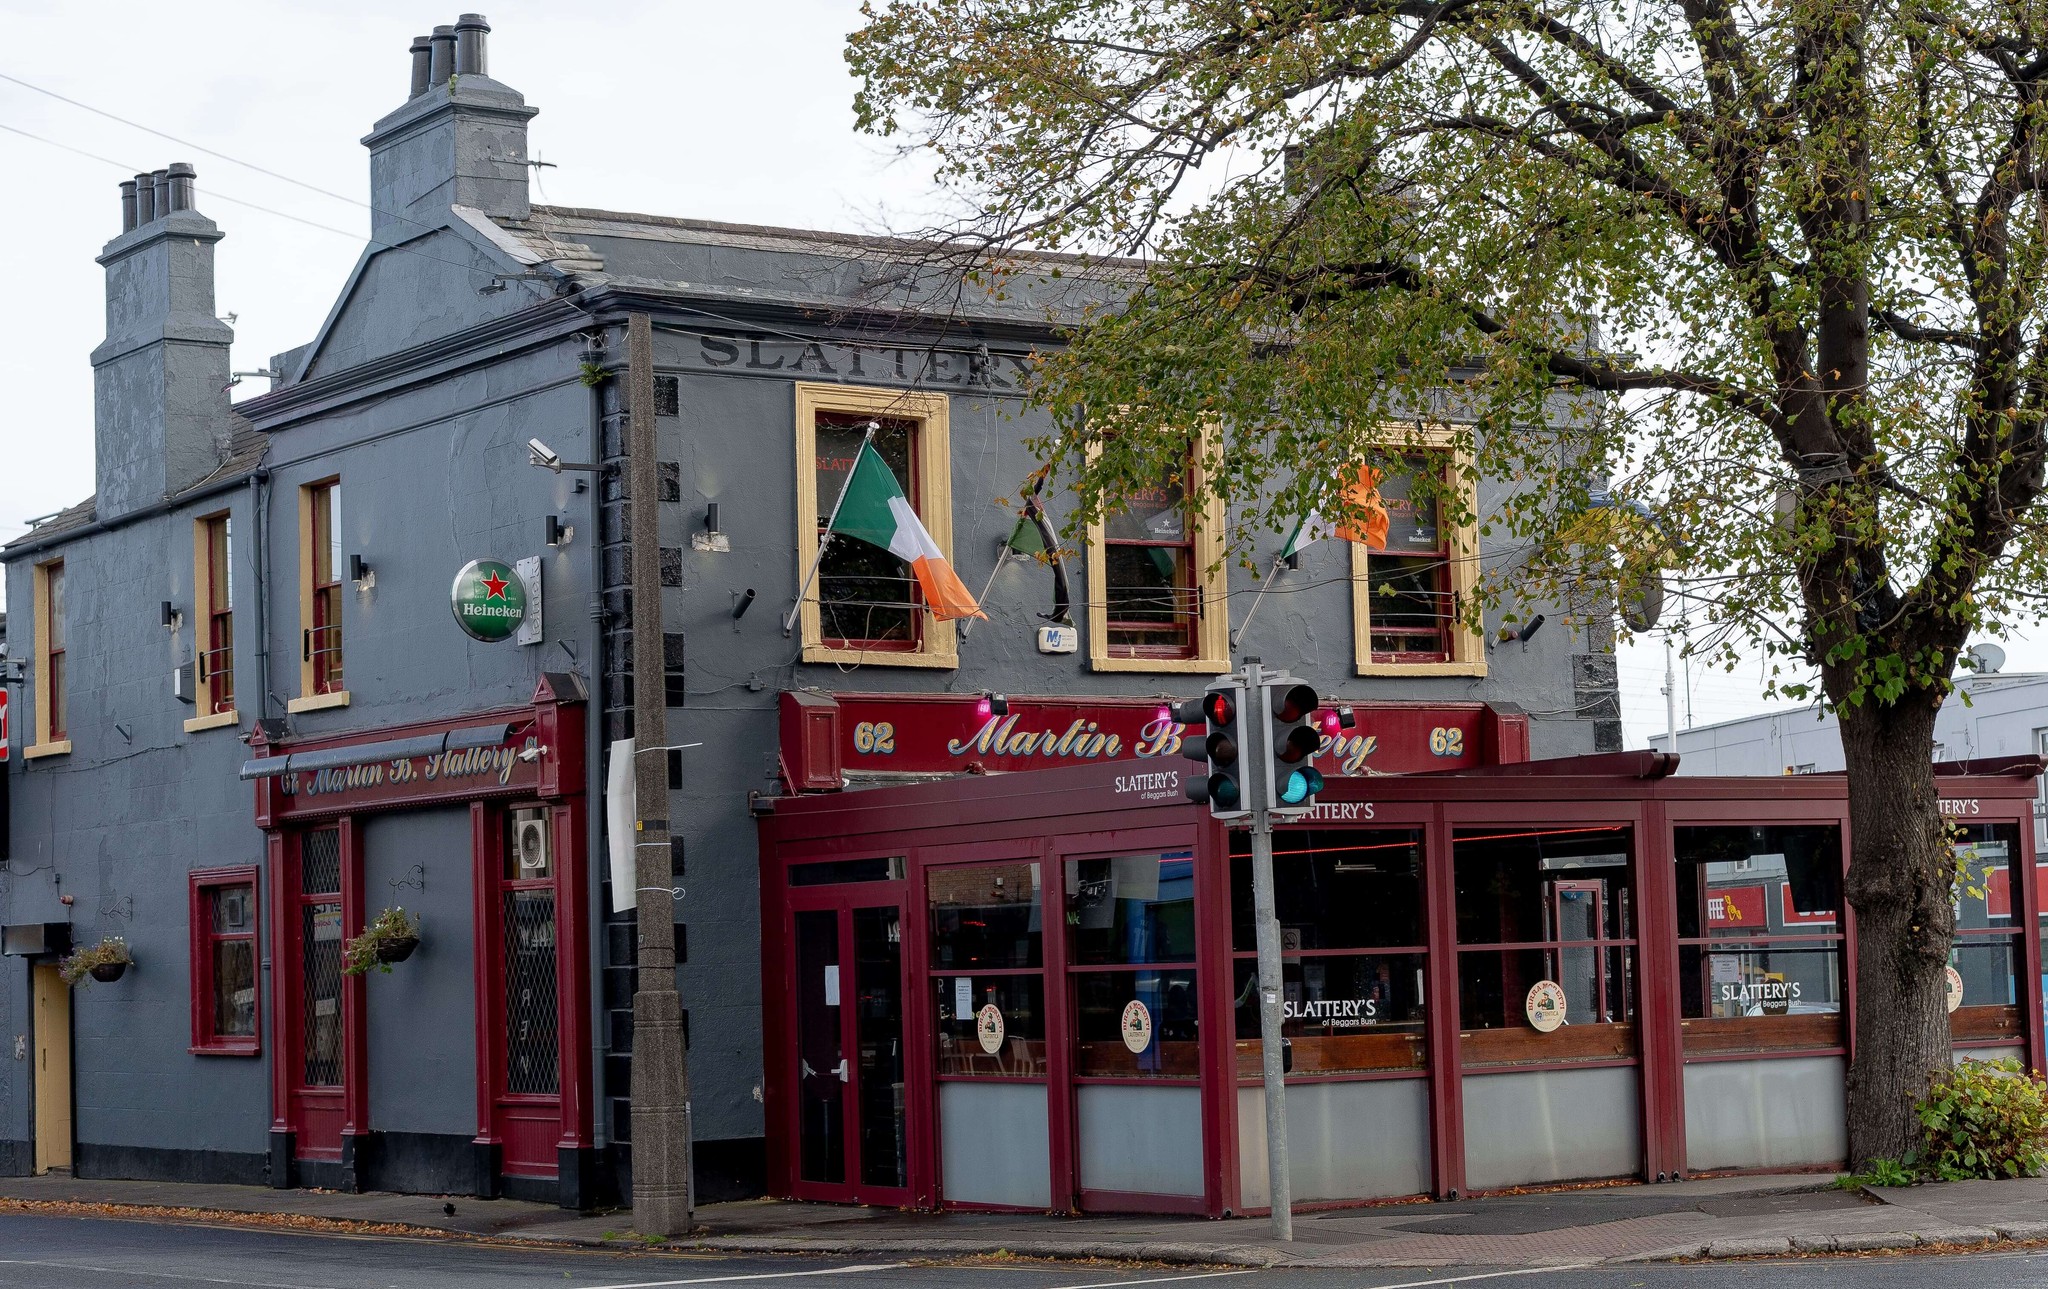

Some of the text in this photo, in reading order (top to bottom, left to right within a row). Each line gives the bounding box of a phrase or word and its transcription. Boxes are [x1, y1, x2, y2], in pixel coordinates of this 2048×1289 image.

[463, 603, 522, 618] Heineken
[854, 721, 897, 754] 62
[948, 713, 1123, 758] Martin
[1429, 727, 1464, 756] 62
[1115, 771, 1178, 793] SLATTERY'S
[1167, 789, 1178, 797] Bush
[1936, 799, 1980, 814] TERY'S
[1946, 968, 1962, 993] ORETTI
[1721, 982, 1801, 1000] SLATTERY'S
[1283, 999, 1376, 1018] SLATTERY'S
[1762, 1000, 1787, 1008] Beggars
[1331, 1018, 1359, 1027] Beggars
[1360, 1017, 1376, 1025] Bush
